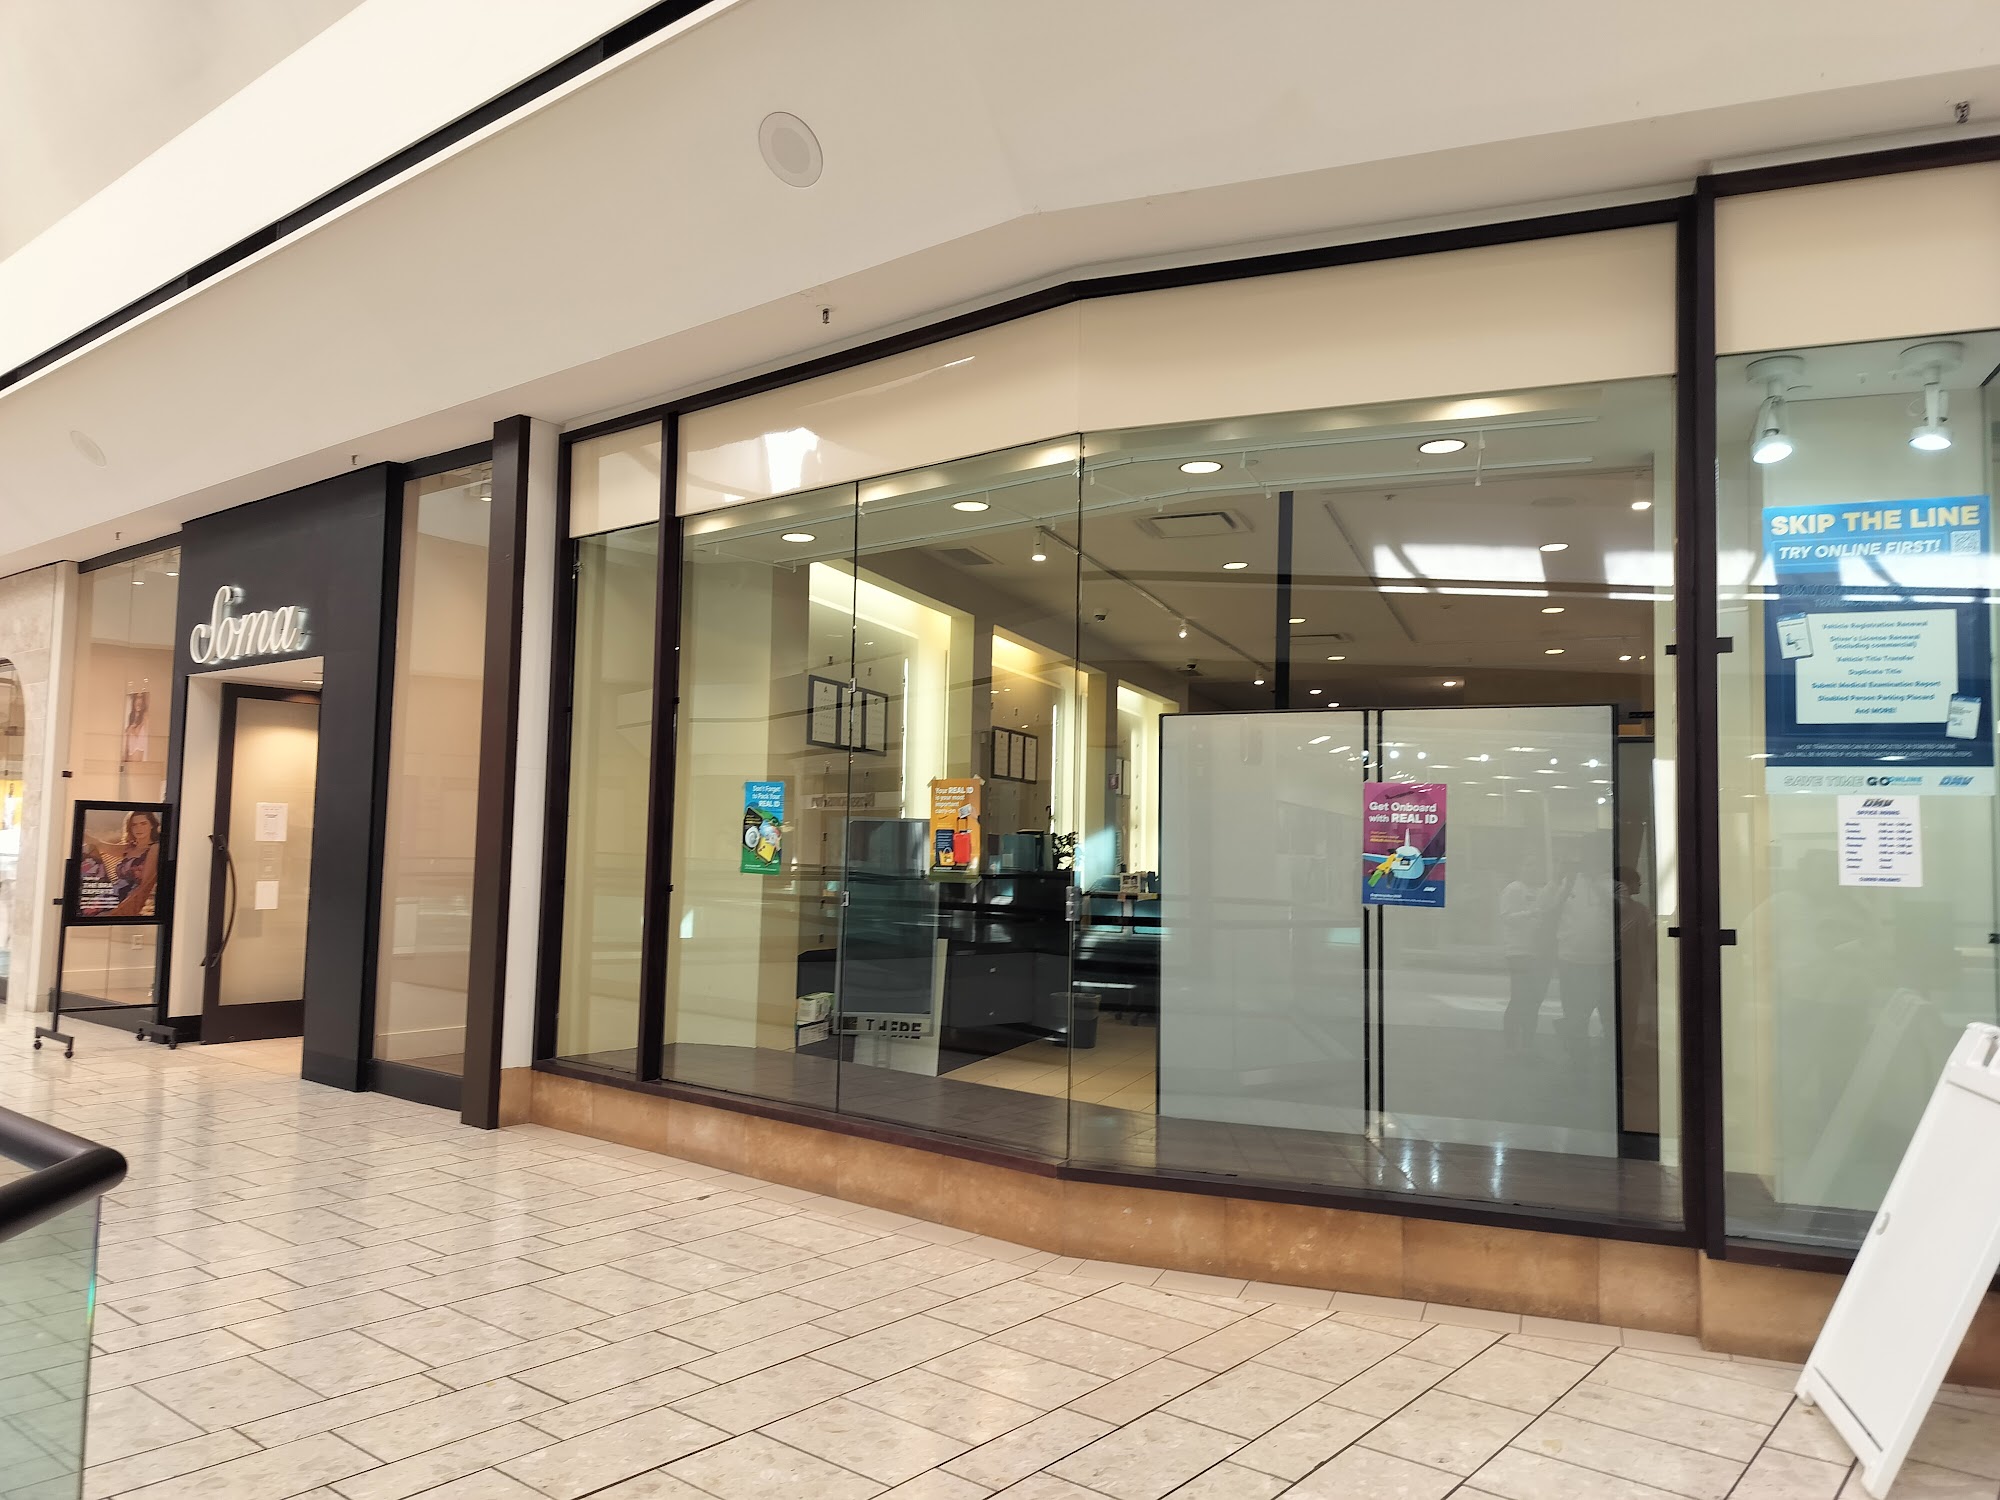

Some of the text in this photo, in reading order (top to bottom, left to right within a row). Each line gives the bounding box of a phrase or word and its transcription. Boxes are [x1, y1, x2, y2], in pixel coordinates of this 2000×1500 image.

[1770, 505, 1980, 536] SKIP THE LINE
[1779, 539, 1941, 559] TRY ONLINE FIRST!
[190, 585, 300, 664] Soma
[1850, 622, 1894, 630] Registration
[1784, 776, 1823, 787] SAVE
[1826, 775, 1865, 787] TIME
[1866, 776, 1890, 786] GO
[1938, 776, 1975, 787] DMV
[948, 786, 966, 794] REAL
[966, 786, 974, 794] ID
[1369, 802, 1437, 813] Get Onboard
[1369, 813, 1438, 824] with REAL ID
